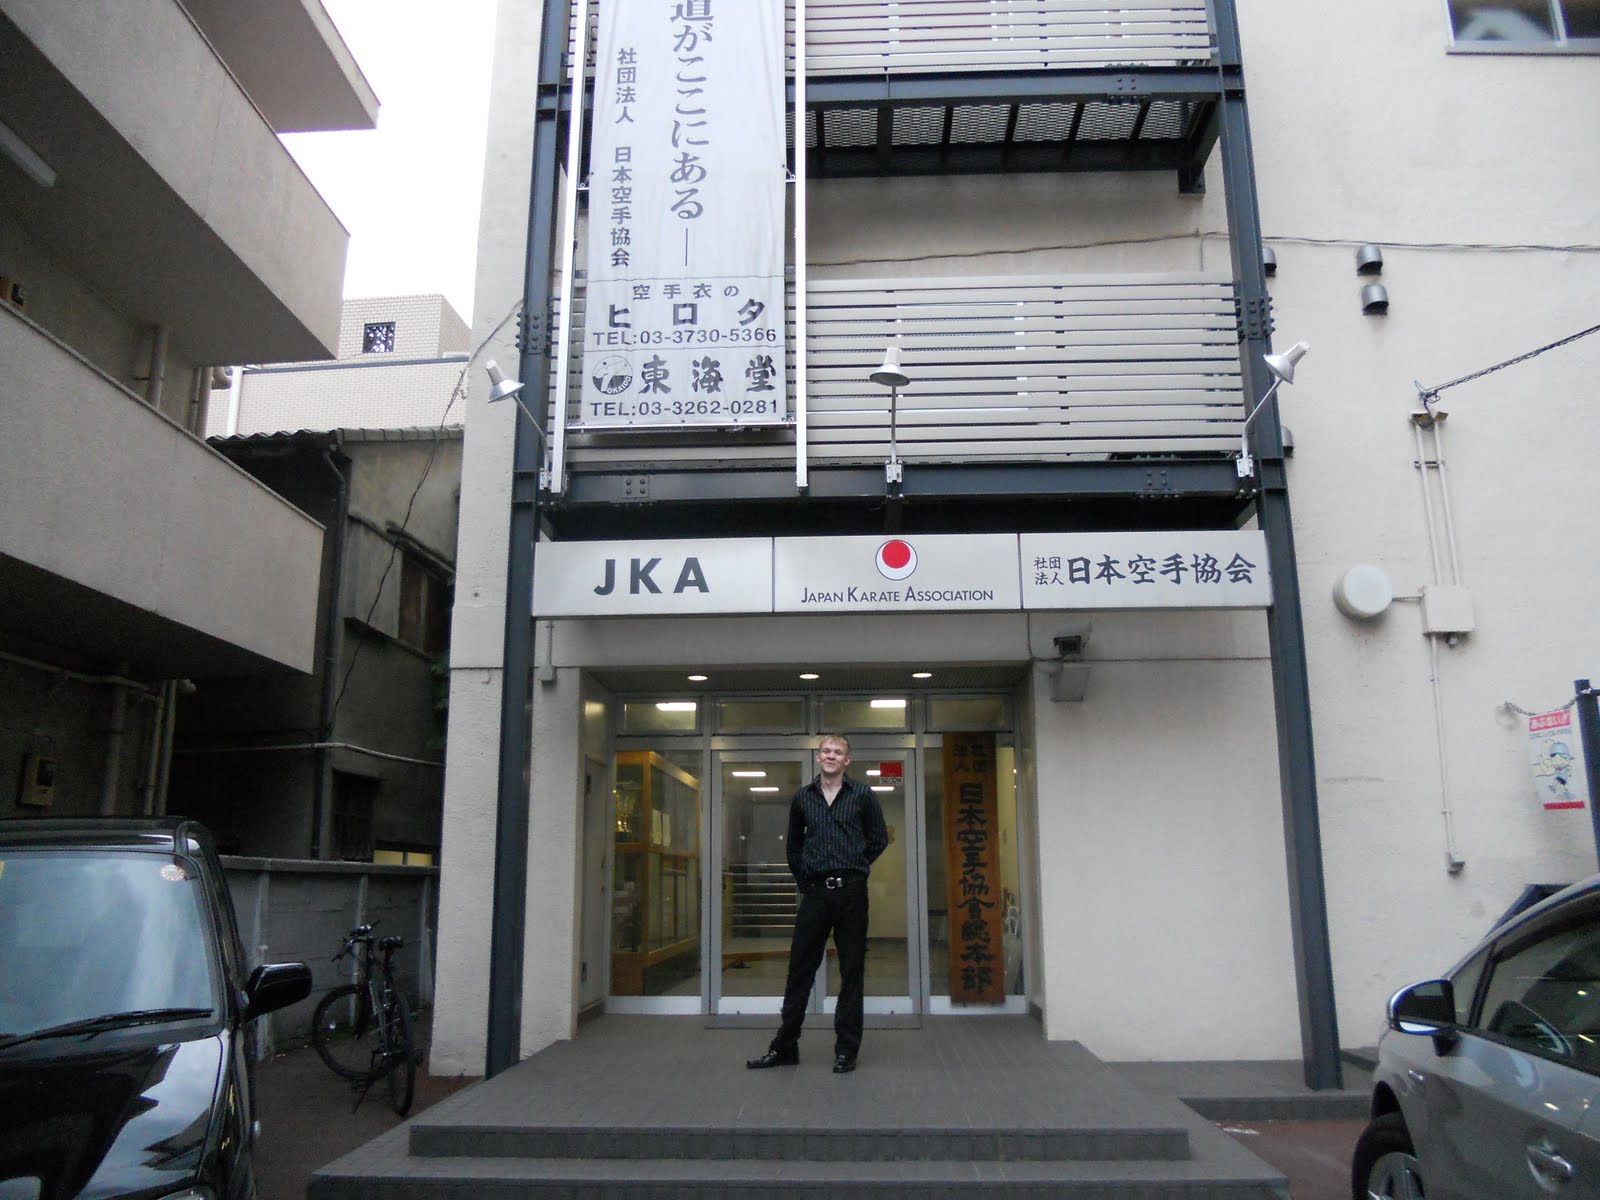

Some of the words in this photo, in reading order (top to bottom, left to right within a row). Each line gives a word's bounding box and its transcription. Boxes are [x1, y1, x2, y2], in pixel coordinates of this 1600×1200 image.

[615, 48, 638, 124] 社団法人
[610, 146, 633, 267] 日本空手協会
[633, 283, 739, 300] 空手衣の
[593, 328, 777, 346] TEL:03-3730-5366
[638, 354, 776, 394] 東海堂
[590, 400, 778, 417] TEL:03-3262-0281
[593, 557, 710, 595] JKA
[1067, 553, 1256, 586] 日本空手協会
[801, 587, 844, 603] JAPAN
[847, 586, 900, 602] KARATE
[904, 586, 994, 602] ASSOCIATION
